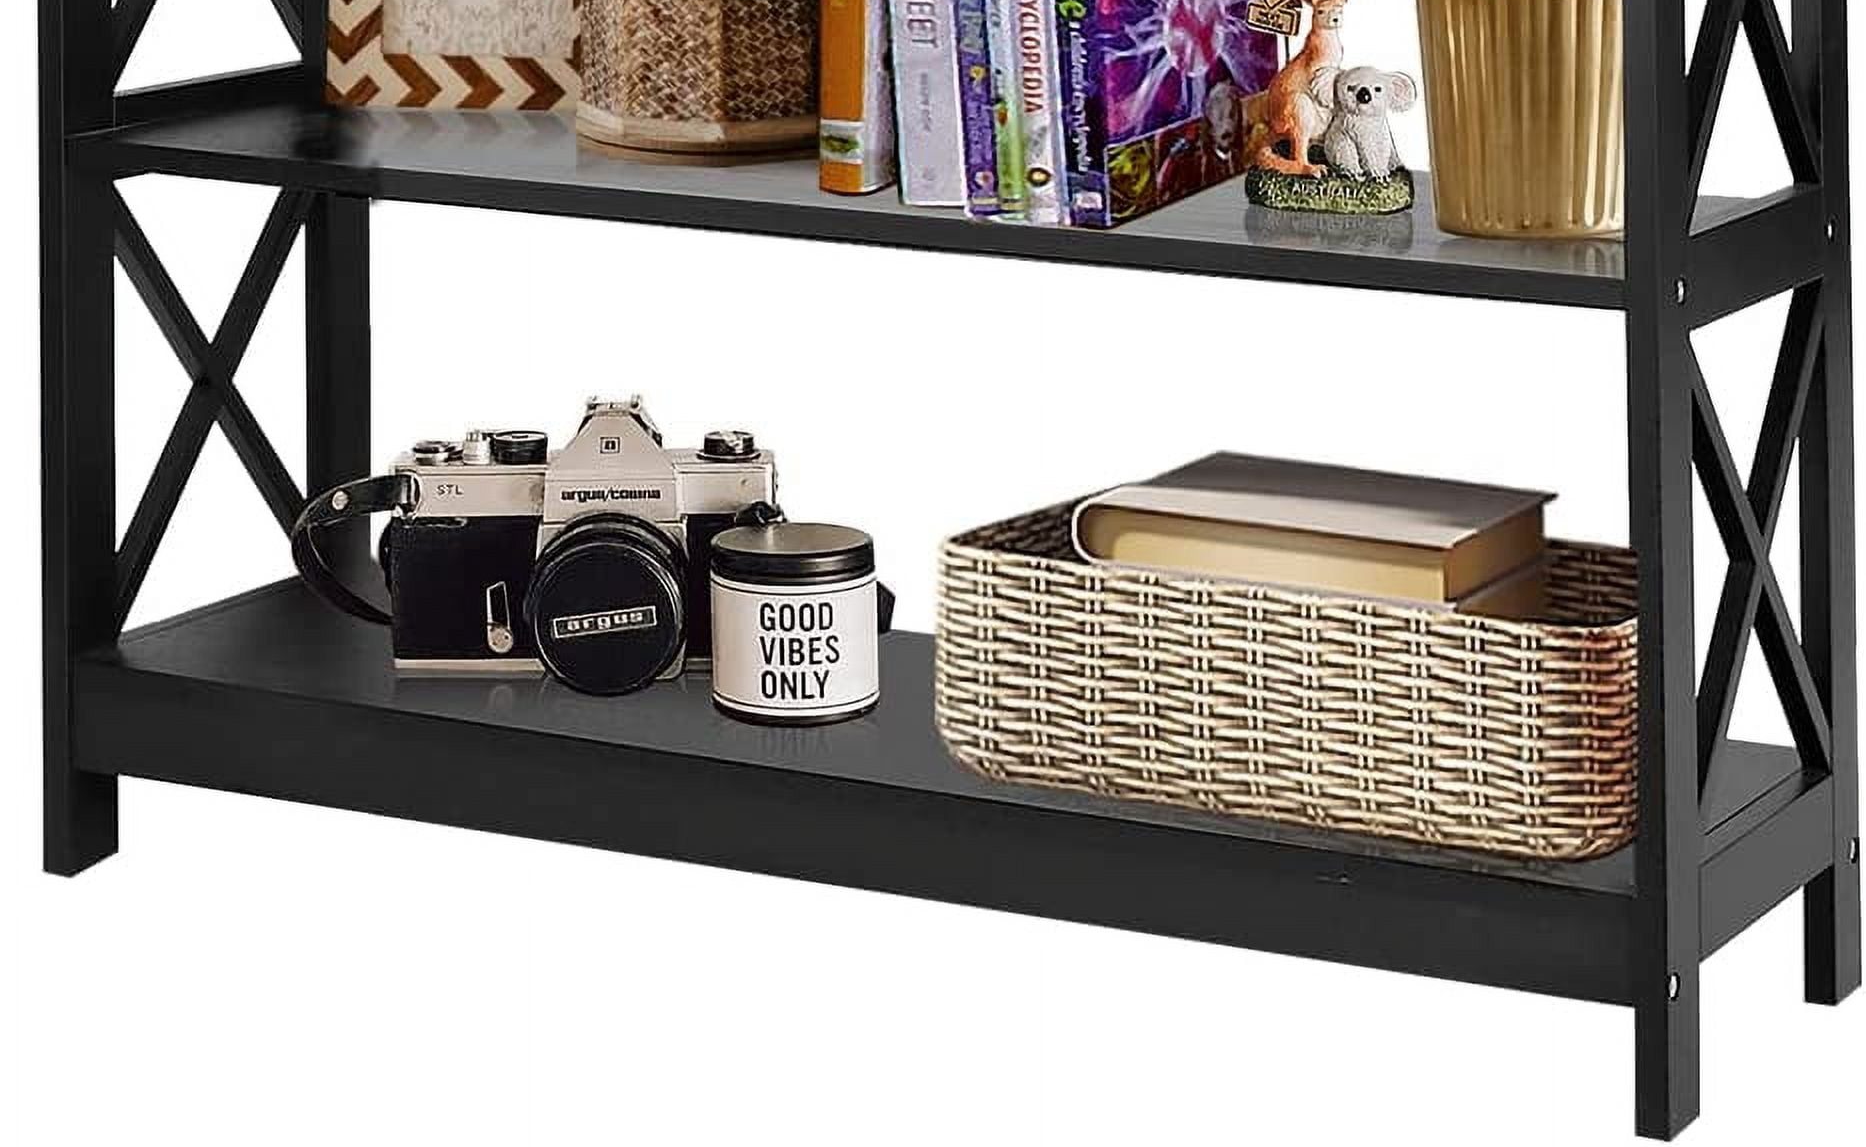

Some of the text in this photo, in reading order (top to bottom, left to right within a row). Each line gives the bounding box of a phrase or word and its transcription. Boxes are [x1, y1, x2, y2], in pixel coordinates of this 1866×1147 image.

[1292, 179, 1367, 199] AUSTRALIA
[437, 484, 463, 496] STL
[566, 611, 644, 631] argus
[760, 602, 834, 632] GOOD
[760, 635, 840, 667] VIBES
[760, 670, 830, 701] ONLY
